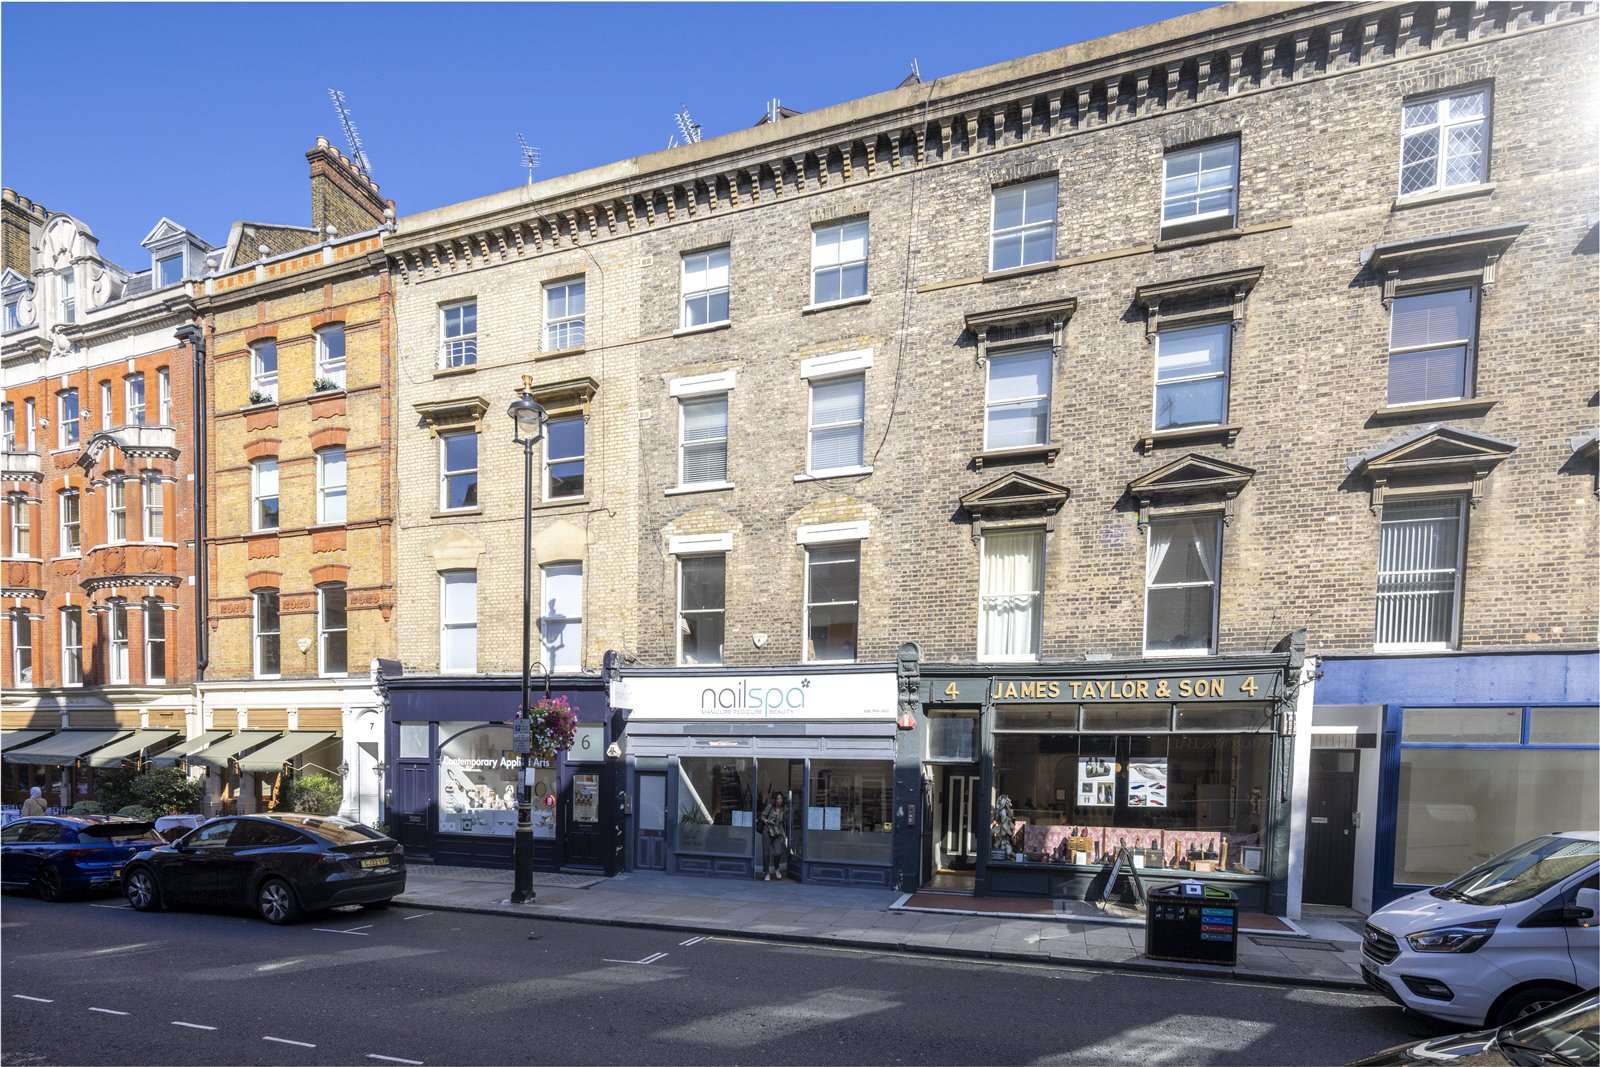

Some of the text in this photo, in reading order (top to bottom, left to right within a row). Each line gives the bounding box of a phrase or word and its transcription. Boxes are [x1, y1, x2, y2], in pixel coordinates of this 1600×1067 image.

[944, 681, 960, 700] 4
[992, 678, 1225, 700] JAMES TAYLOR & SON
[1240, 676, 1259, 697] 4
[701, 679, 805, 717] nailspa
[369, 722, 375, 731] 7
[581, 734, 591, 750] 6
[500, 756, 531, 770] Appli
[533, 757, 550, 767] Arts
